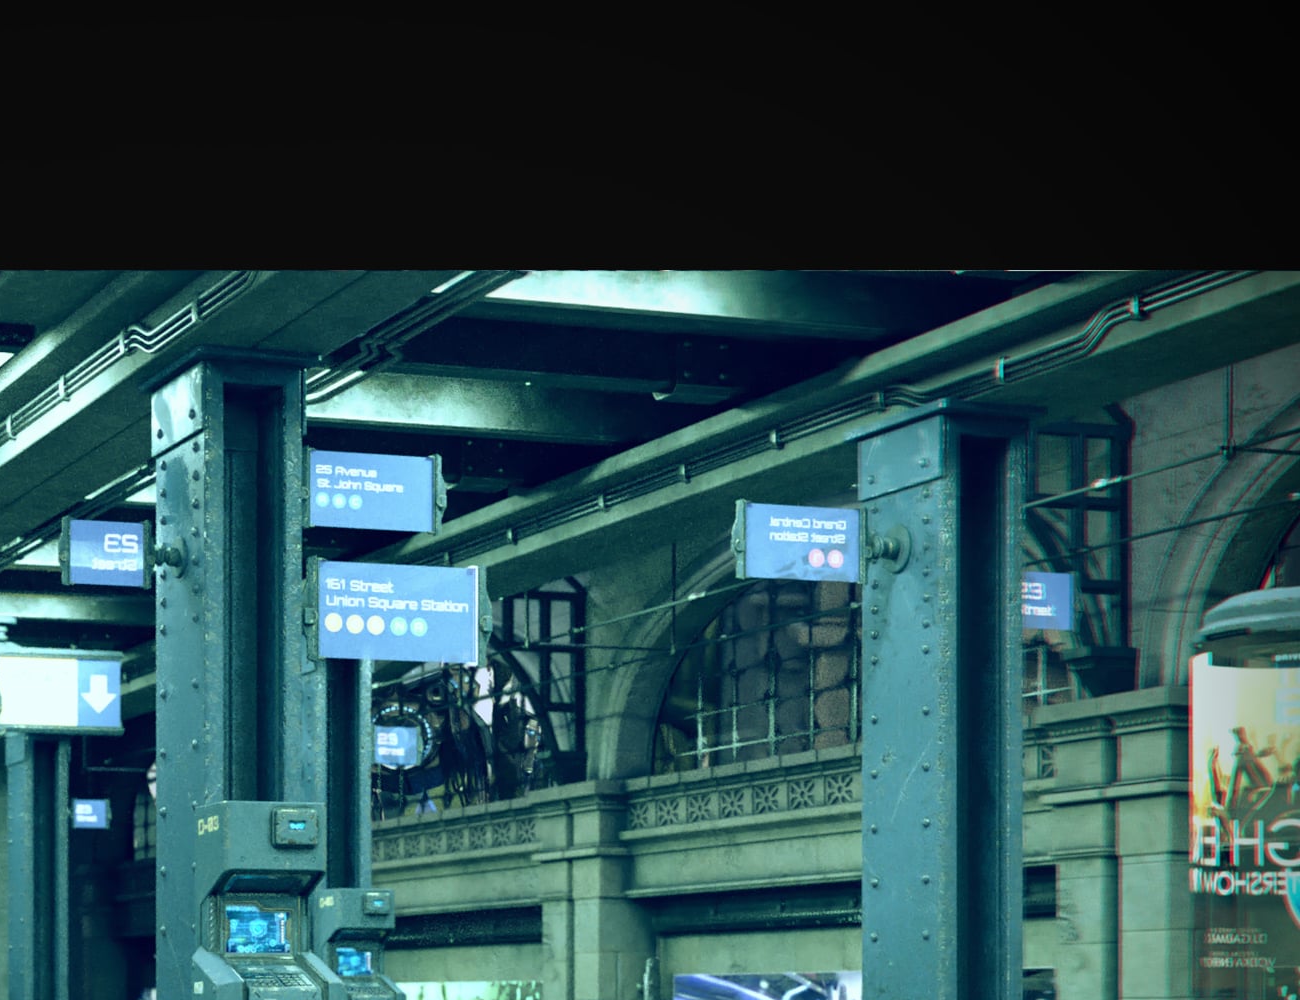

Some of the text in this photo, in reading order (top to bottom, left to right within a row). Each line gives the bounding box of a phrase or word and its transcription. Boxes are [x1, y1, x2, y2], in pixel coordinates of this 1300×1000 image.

[315, 464, 378, 479] 25 Avenue
[334, 479, 362, 491] John
[364, 481, 404, 494] Square
[325, 577, 395, 594] 161 Street
[325, 595, 469, 614] Union Square Station
